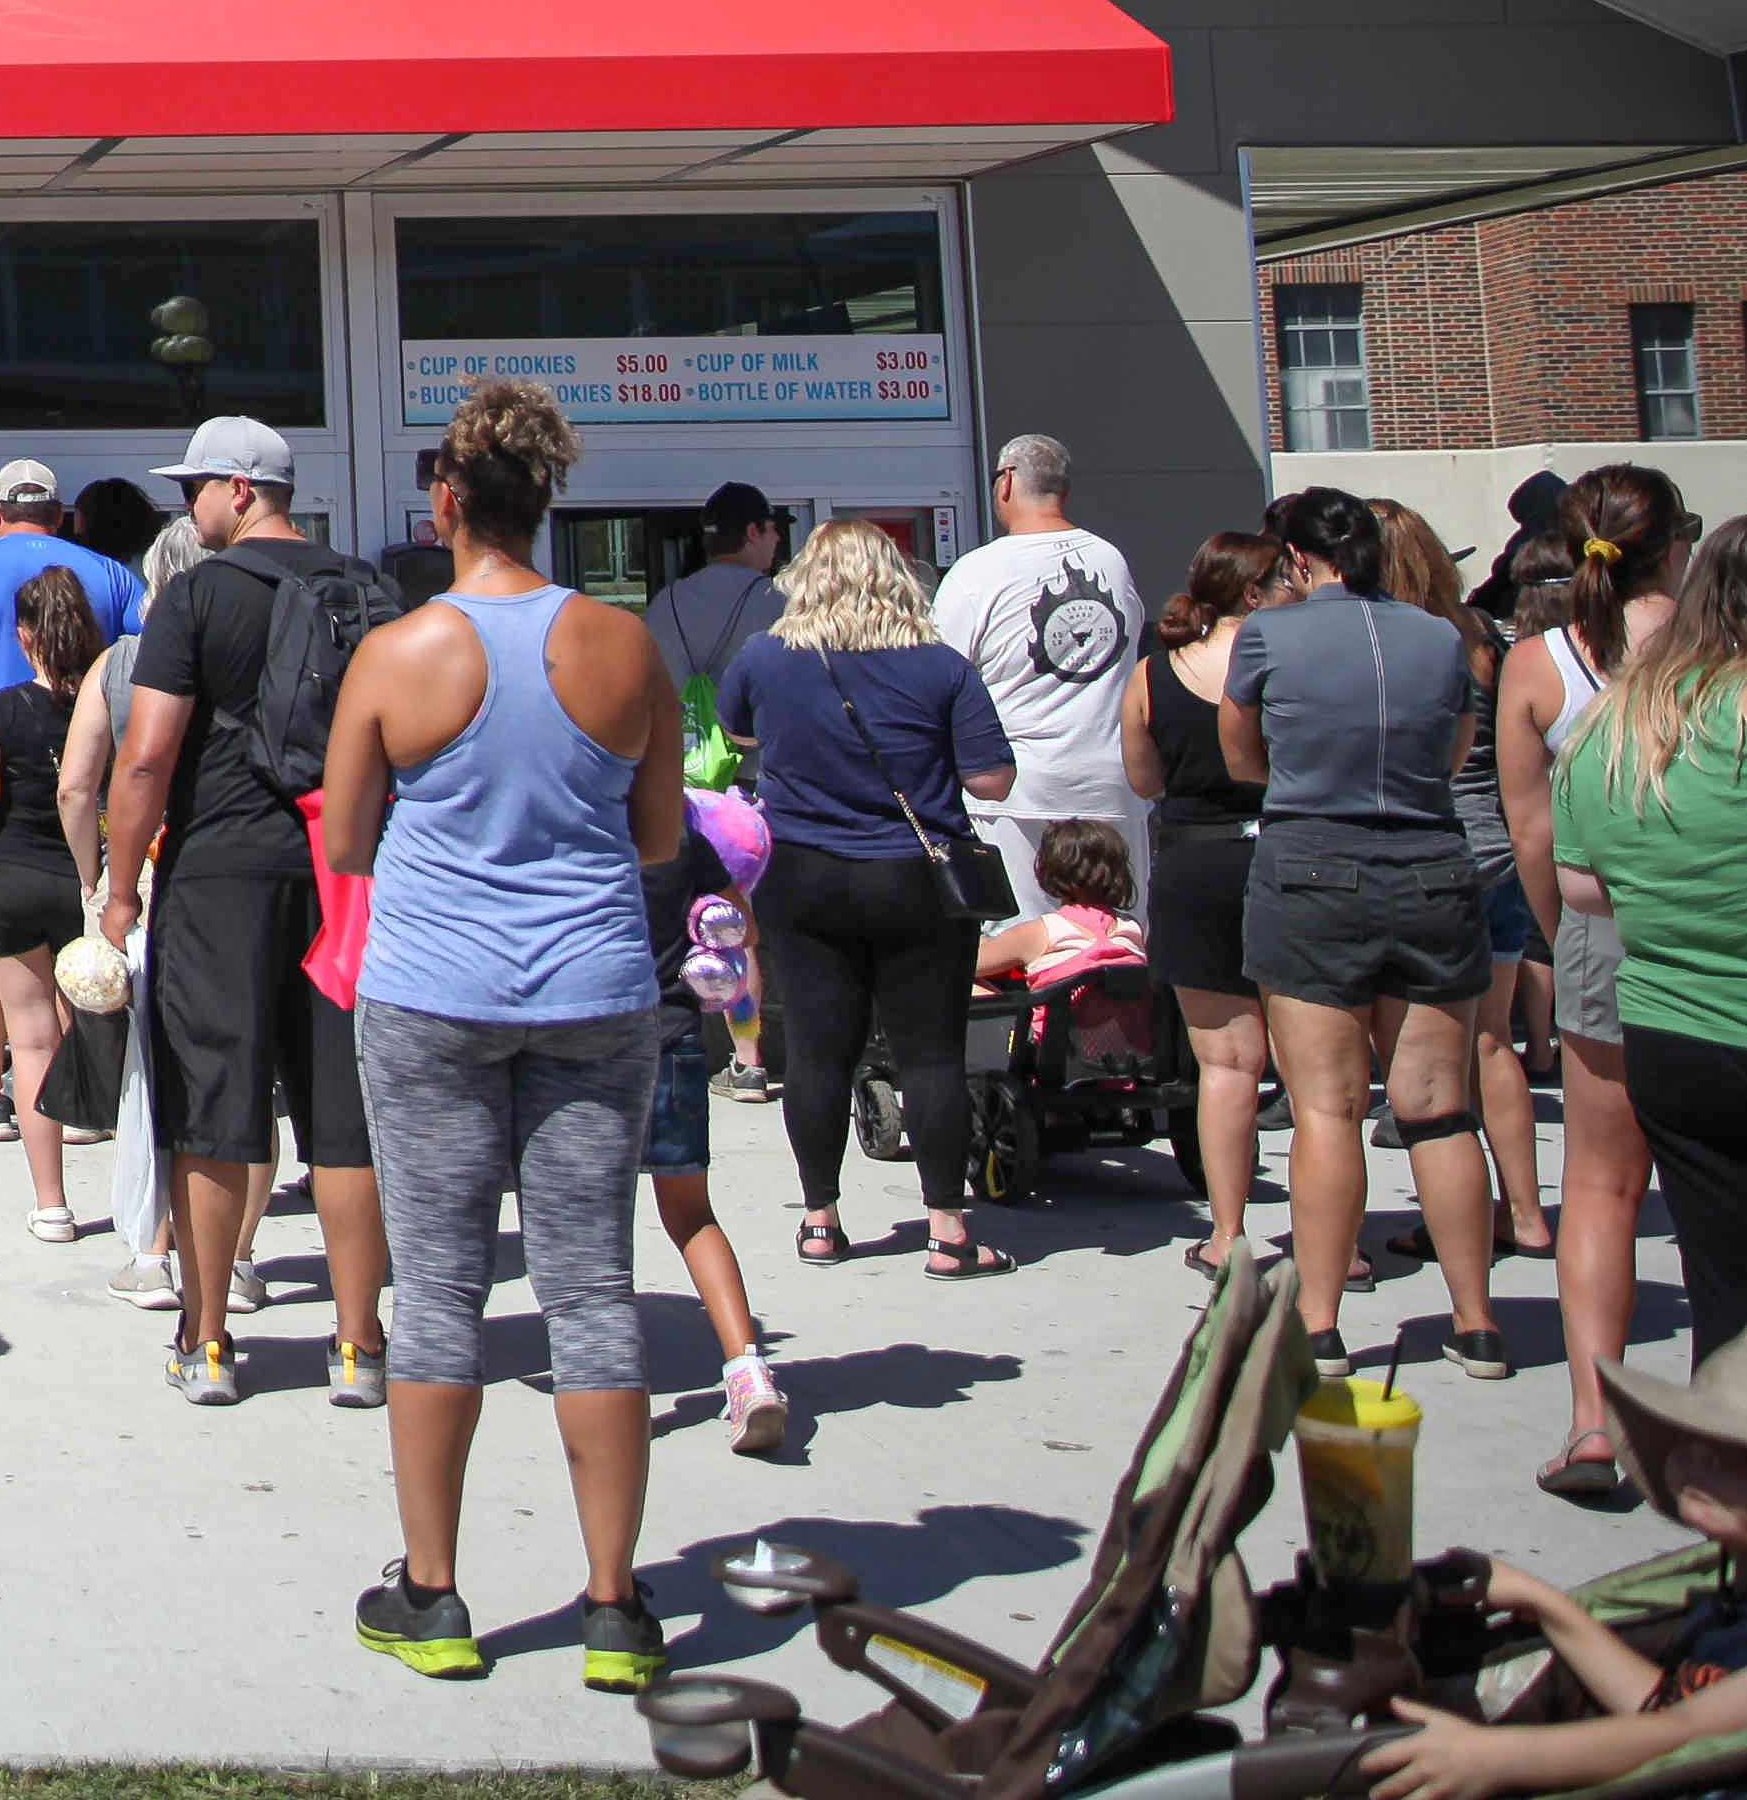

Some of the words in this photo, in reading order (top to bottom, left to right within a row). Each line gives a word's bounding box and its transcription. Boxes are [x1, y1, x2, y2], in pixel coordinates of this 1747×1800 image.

[419, 356, 457, 375] CUP
[464, 356, 488, 375] OF
[495, 355, 576, 375] COOKIES
[617, 354, 667, 374] $5.00
[697, 353, 734, 372] CUP
[741, 353, 765, 372] OF
[772, 352, 818, 371] MILK
[876, 351, 927, 371] $3.00
[421, 385, 471, 405] BUCK
[554, 384, 611, 403] OKIES
[618, 384, 680, 404] $18.00
[698, 382, 768, 401] BOTTLE
[775, 382, 799, 401] OF
[806, 381, 871, 400] WATER
[878, 380, 929, 400] $3.00
